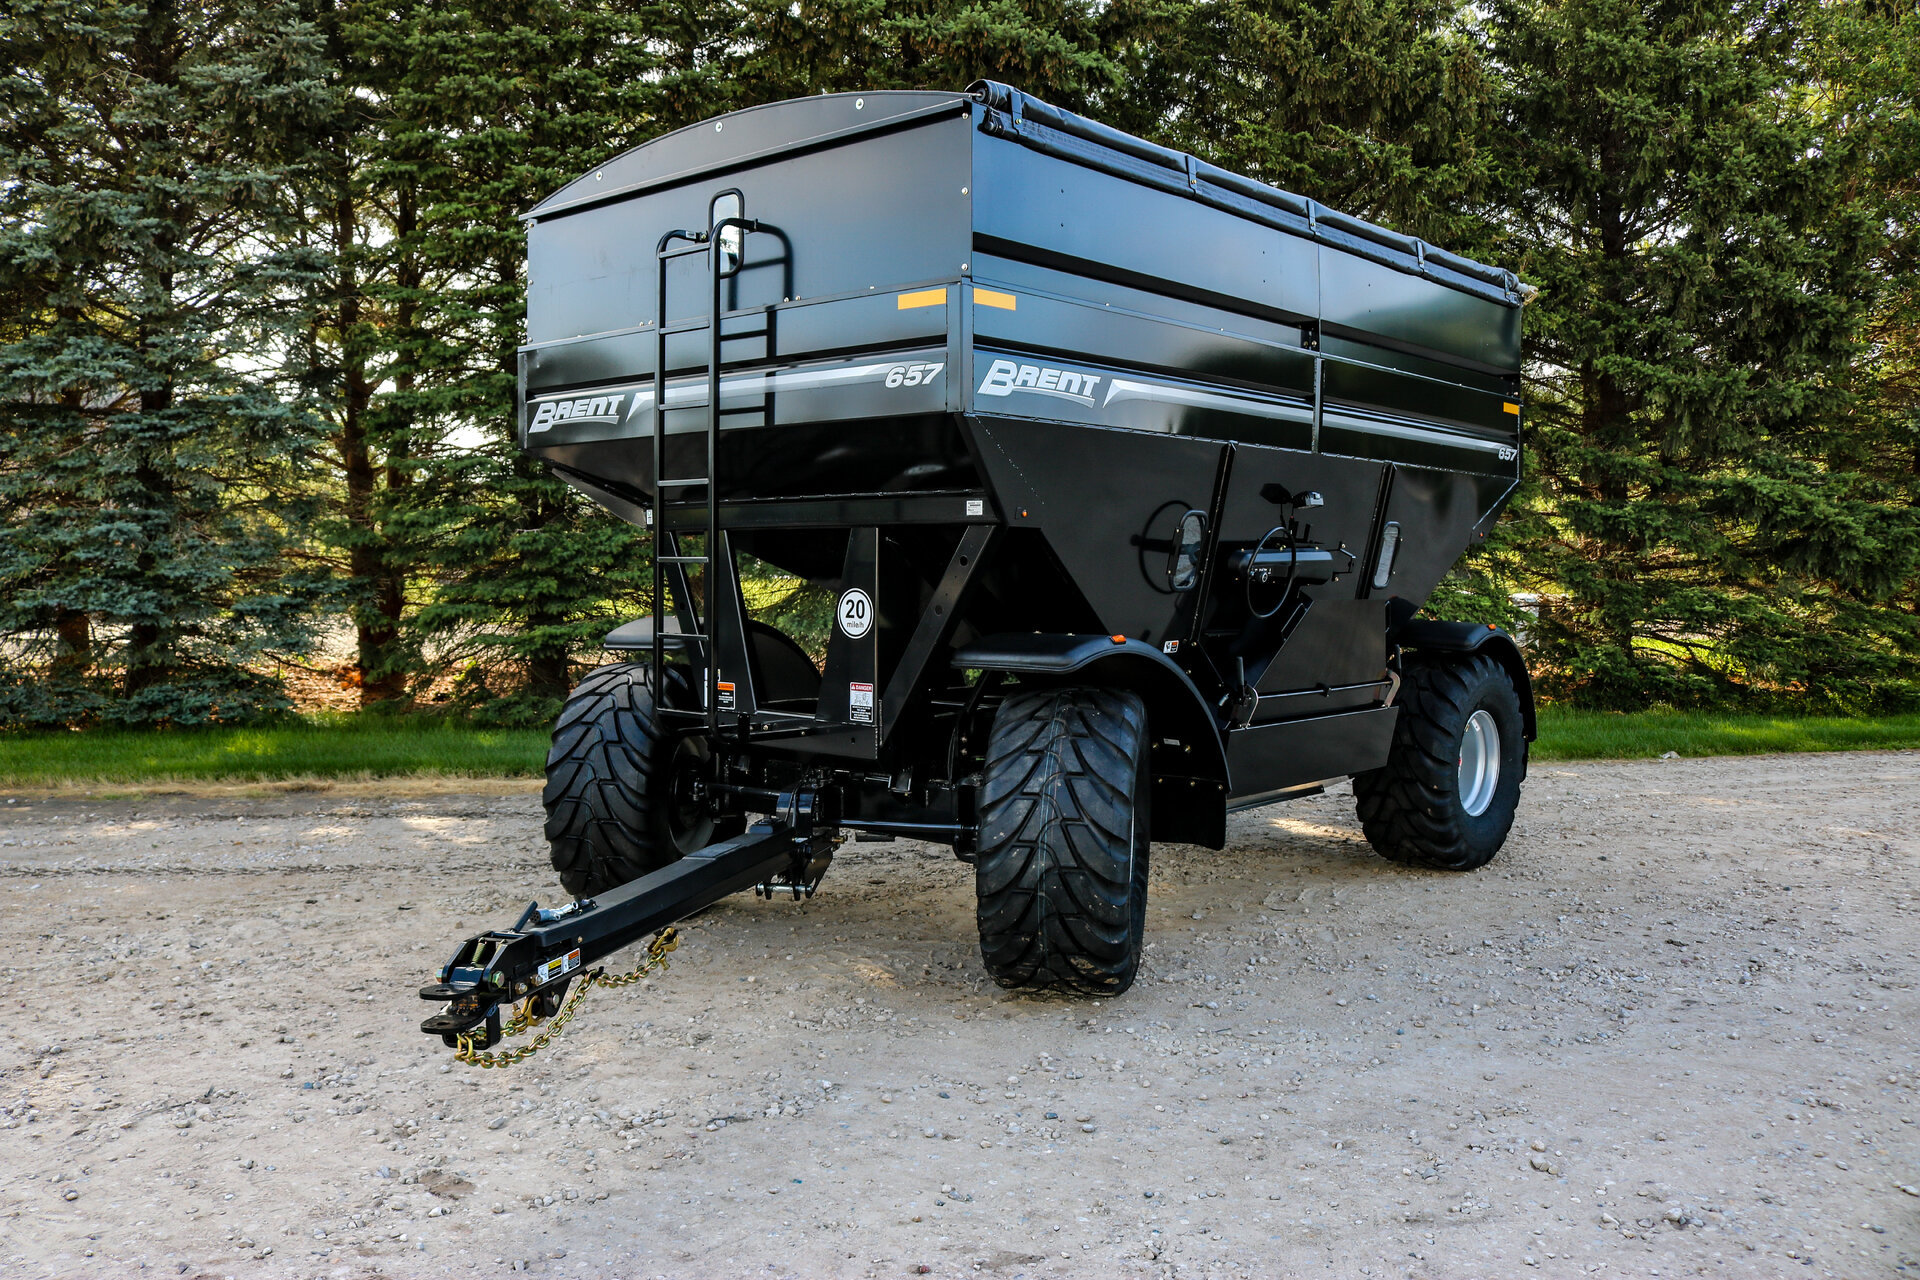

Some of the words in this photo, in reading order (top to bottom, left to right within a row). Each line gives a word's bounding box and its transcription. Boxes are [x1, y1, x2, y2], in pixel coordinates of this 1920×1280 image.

[885, 363, 945, 389] 657
[977, 359, 1102, 397] BRENT
[528, 394, 626, 434] BRENT
[1498, 446, 1518, 461] 657
[845, 599, 865, 619] 20
